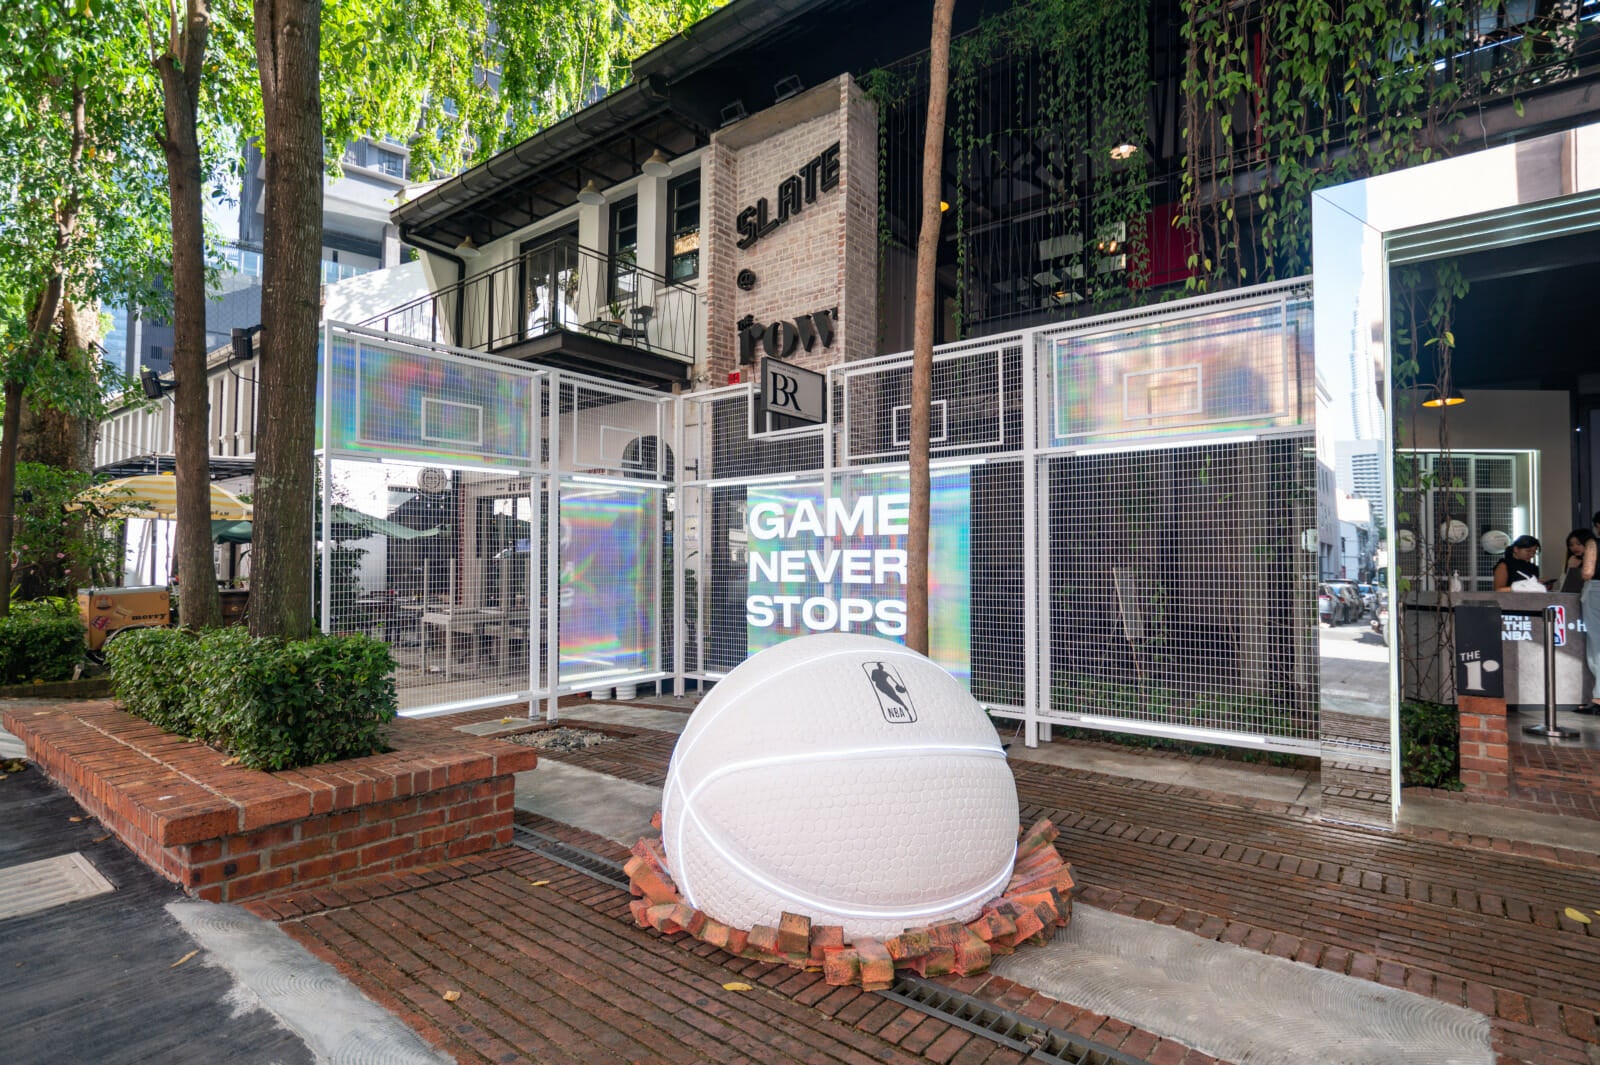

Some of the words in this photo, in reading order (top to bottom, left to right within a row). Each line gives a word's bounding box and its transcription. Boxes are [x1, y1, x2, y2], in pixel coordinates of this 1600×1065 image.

[736, 141, 841, 250] SLATE
[737, 268, 756, 291] @
[770, 371, 801, 411] BR
[749, 495, 909, 540] GAME
[749, 549, 907, 584] NEVER
[746, 595, 907, 636] STOPS
[1503, 621, 1532, 630] THE
[1501, 631, 1532, 641] NBA
[1459, 650, 1481, 661] THE
[887, 707, 905, 718] NBA
